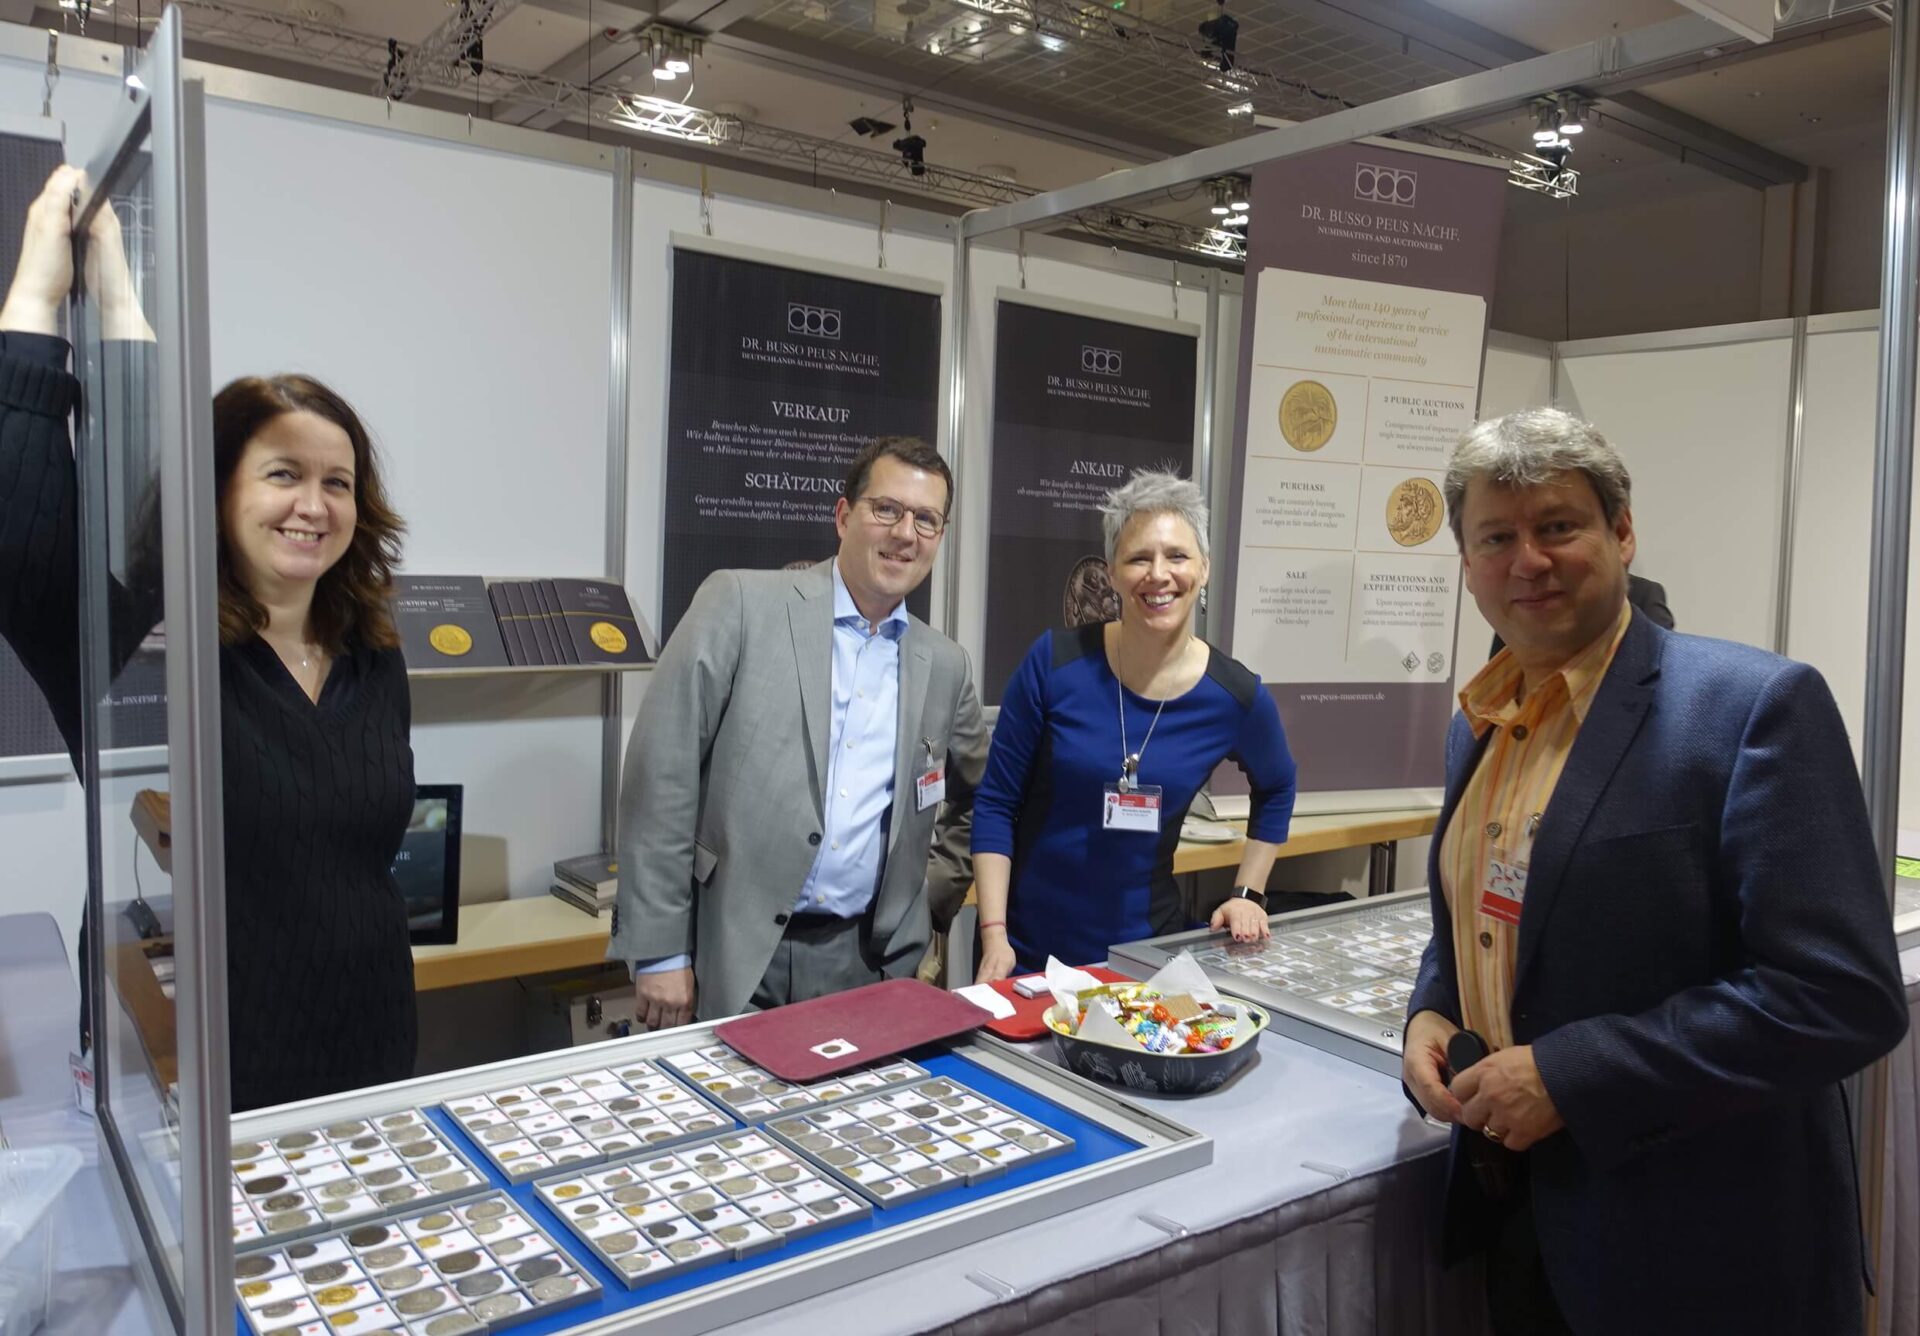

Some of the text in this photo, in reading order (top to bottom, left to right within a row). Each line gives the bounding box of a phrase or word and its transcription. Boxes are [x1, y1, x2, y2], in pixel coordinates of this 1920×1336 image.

[1302, 205, 1460, 241] DR. BUSSO PEUS NACHF.
[1318, 226, 1443, 251] NUMISMATISTS AND AUCTIONEERS
[1351, 249, 1408, 268] since 1870
[1322, 295, 1430, 320] More than 140 years of
[1296, 310, 1449, 337] professional experience in service
[1327, 328, 1418, 348] of the international
[742, 337, 879, 367] DR. BUSSO PEUS NACHF.
[1315, 345, 1427, 366] numismatic community
[1047, 374, 1062, 387] DR.
[1066, 378, 1094, 390] BUSSO
[1095, 382, 1118, 394] PEUS
[772, 400, 851, 423] VERKAUF
[1391, 396, 1421, 406] PUBLIC
[1423, 399, 1465, 409] AUCTIONS
[1409, 407, 1439, 417] A YEAR
[1070, 460, 1125, 478] ANKAUF
[745, 472, 846, 494] SCHÄTZUNG
[1280, 481, 1325, 492] PURCHASE
[1286, 571, 1307, 579] SALE
[1370, 574, 1445, 584] ESTIMATIONS AND
[1364, 583, 1449, 593] EXPERT COUNSELING
[1300, 691, 1386, 704] www.peus-muenzen.de
